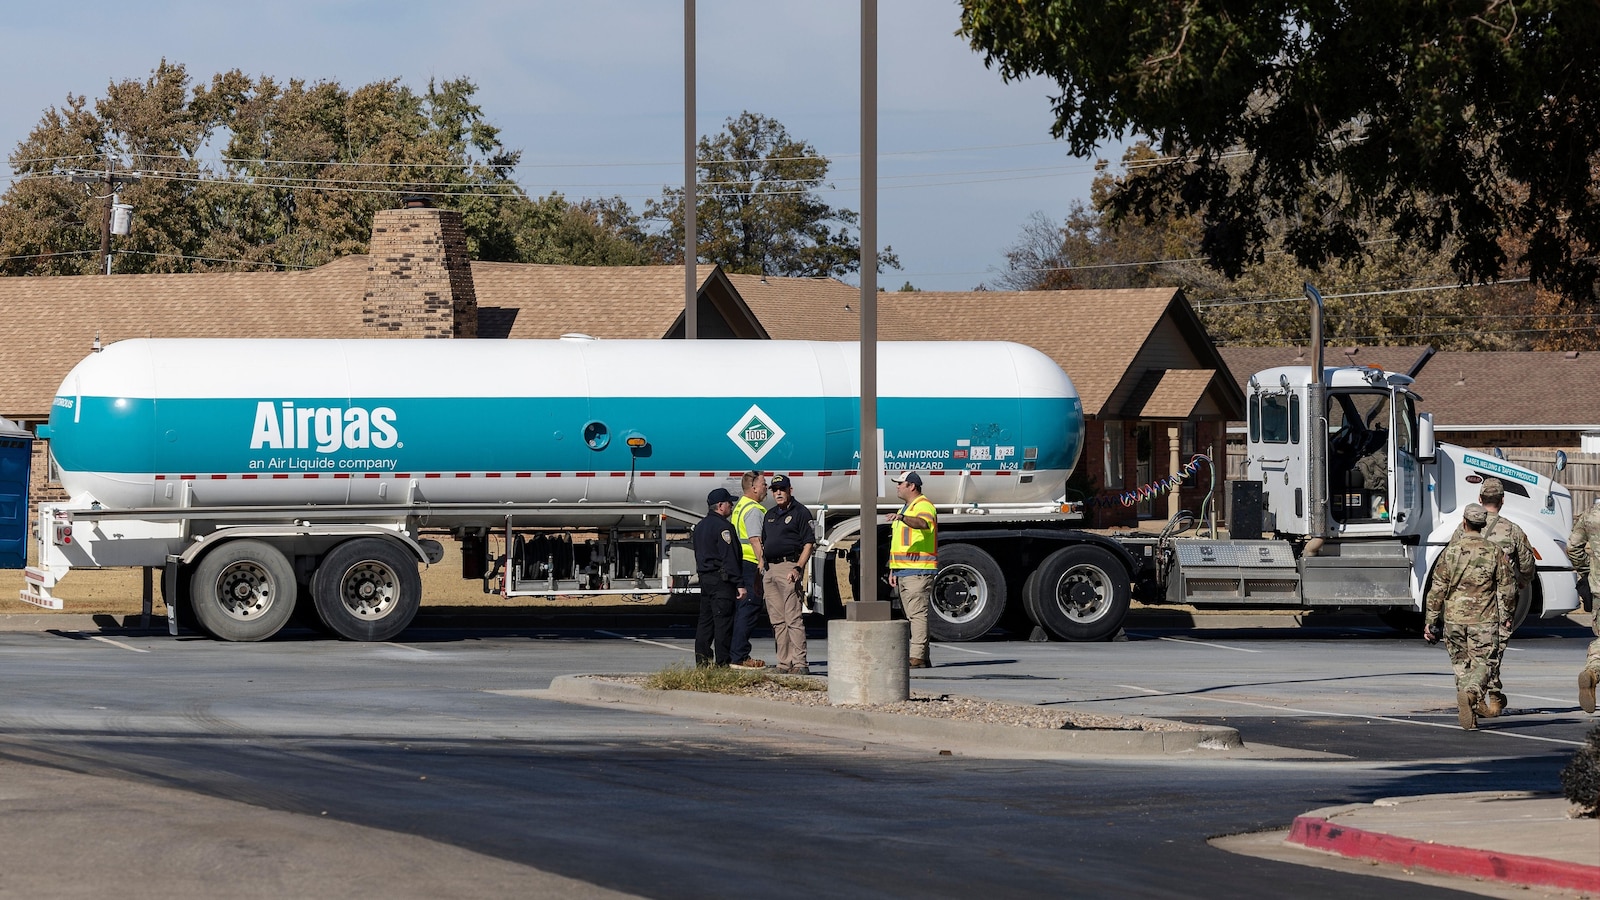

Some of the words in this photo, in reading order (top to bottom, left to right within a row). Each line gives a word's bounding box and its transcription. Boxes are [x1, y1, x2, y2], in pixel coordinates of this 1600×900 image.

[747, 431, 766, 440] 1005
[853, 450, 895, 460] AIA,
[896, 450, 950, 459] ANHYDROUS
[249, 460, 265, 469] an
[268, 457, 285, 469] Air
[288, 457, 335, 471] Liquide
[338, 459, 398, 471] company
[857, 462, 907, 470] IATION
[908, 462, 944, 470] HAZARD
[1000, 462, 1019, 470] N-24
